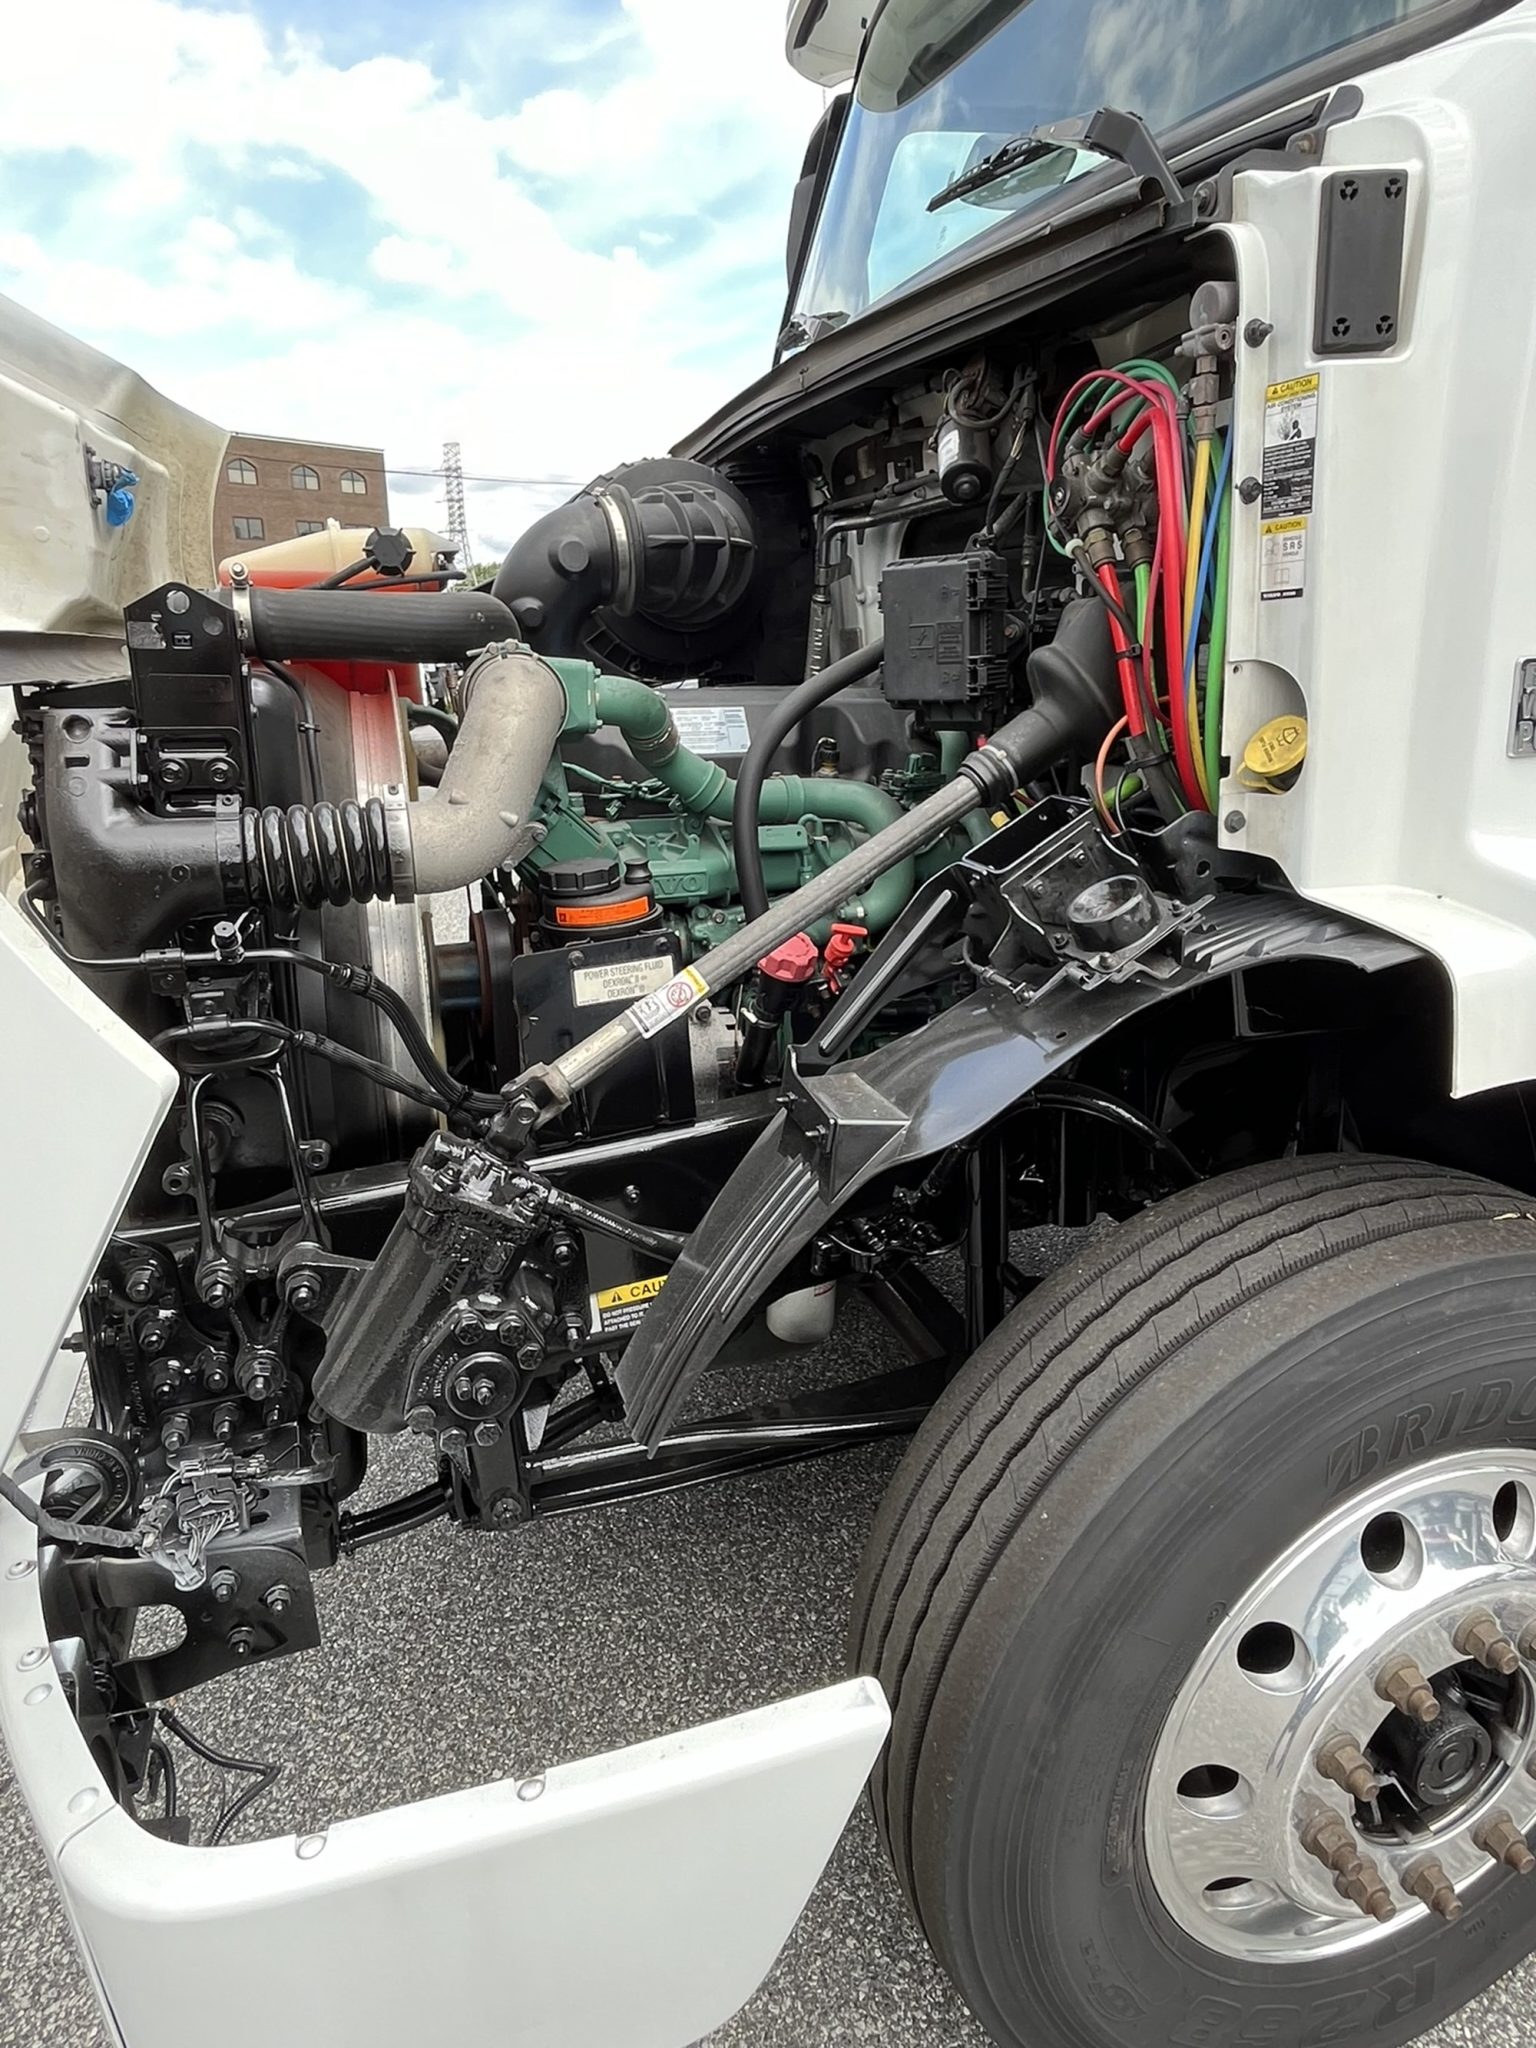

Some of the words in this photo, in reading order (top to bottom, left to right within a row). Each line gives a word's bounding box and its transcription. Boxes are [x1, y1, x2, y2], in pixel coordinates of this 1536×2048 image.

[1280, 378, 1312, 393] CAUTION
[1274, 520, 1302, 531] CAUTION
[584, 968, 609, 980] POWER
[610, 963, 643, 976] STEERING
[644, 960, 664, 970] FLUID
[630, 1279, 667, 1298] CAU
